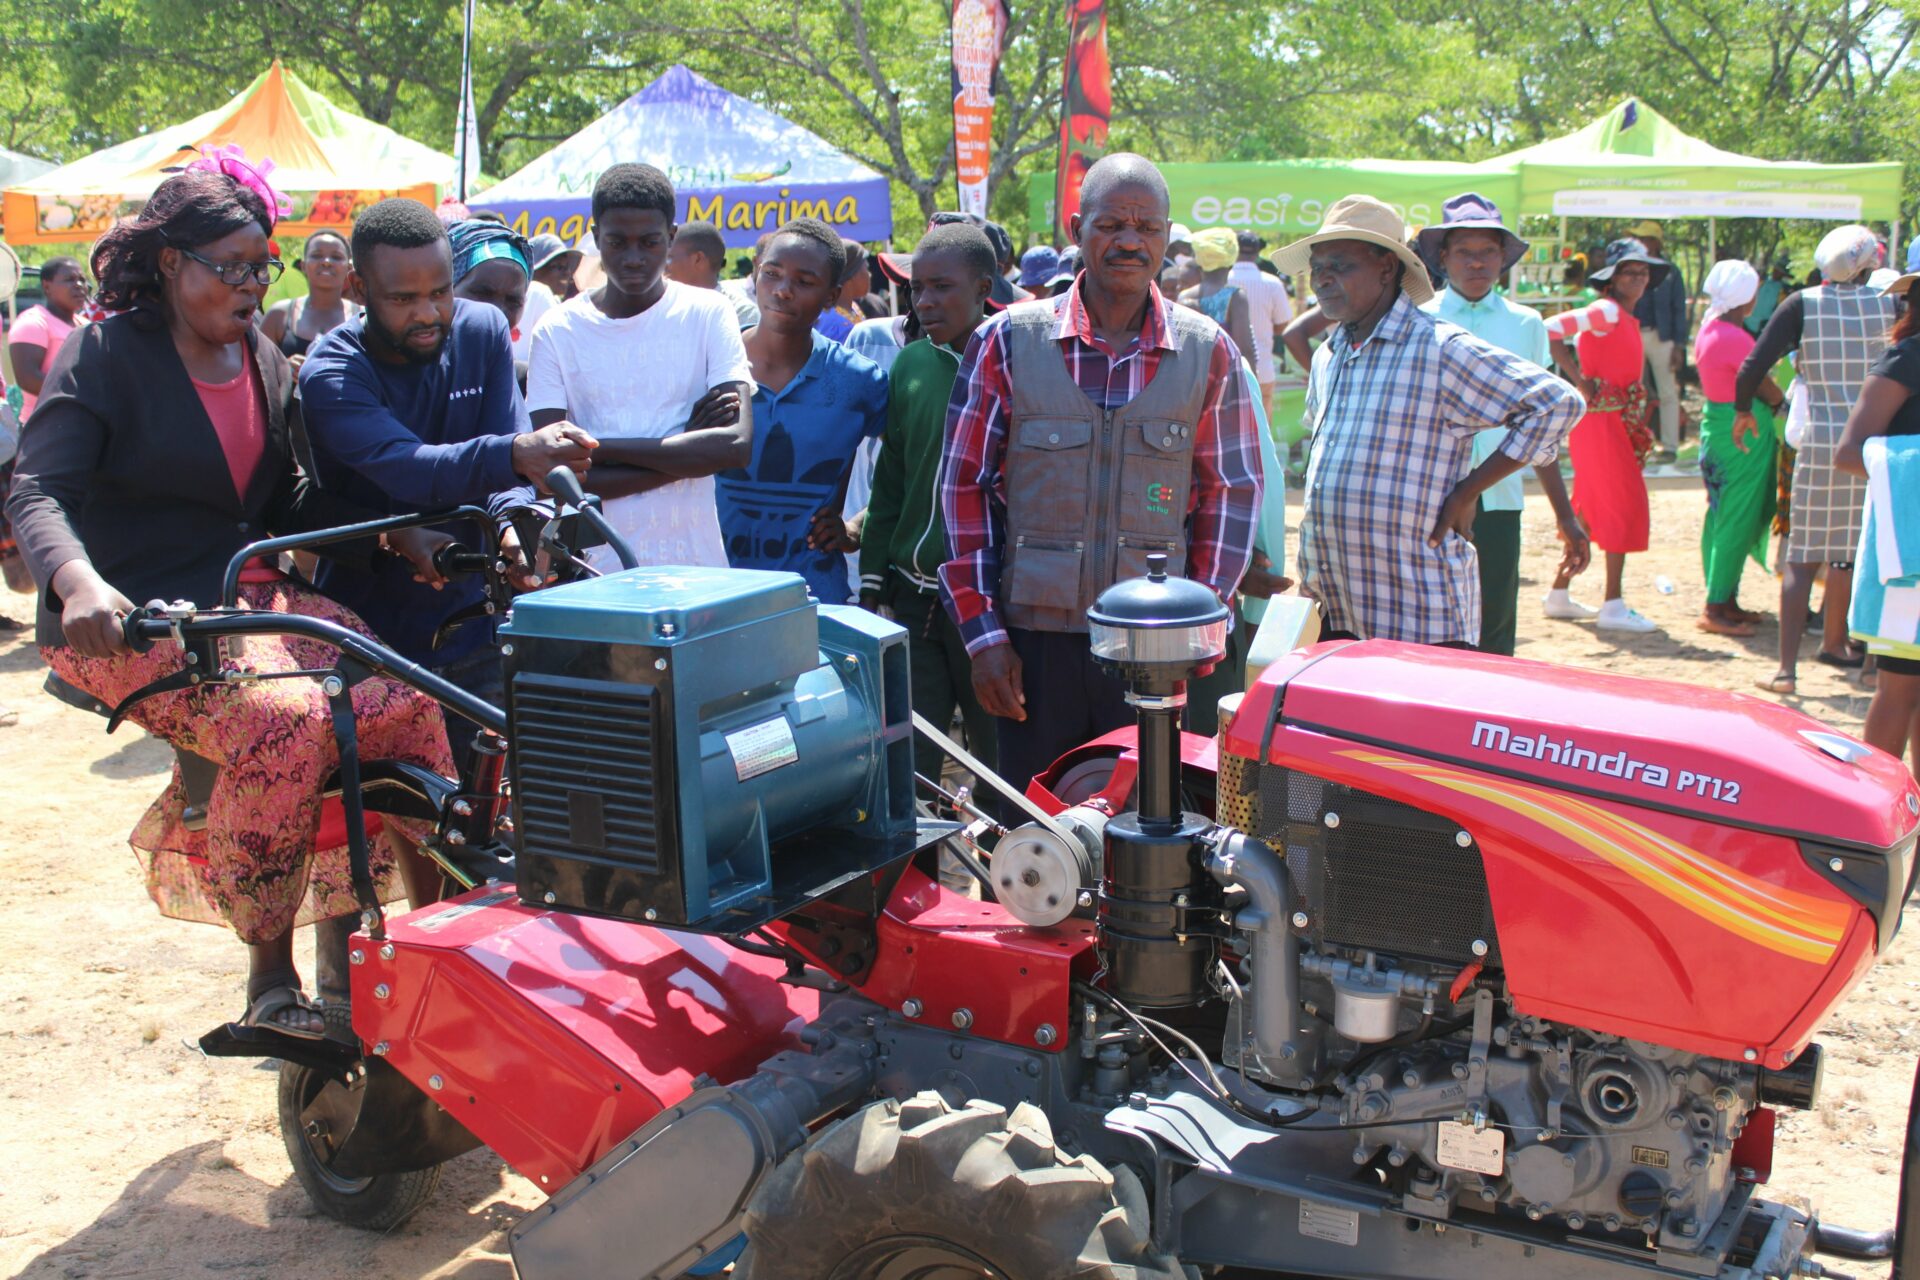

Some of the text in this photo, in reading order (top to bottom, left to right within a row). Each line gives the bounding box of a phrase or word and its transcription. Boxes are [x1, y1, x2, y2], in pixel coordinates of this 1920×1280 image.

[686, 188, 860, 231] Marima
[1191, 193, 1292, 226] easi
[1471, 720, 1742, 804] Mahindra PT12
